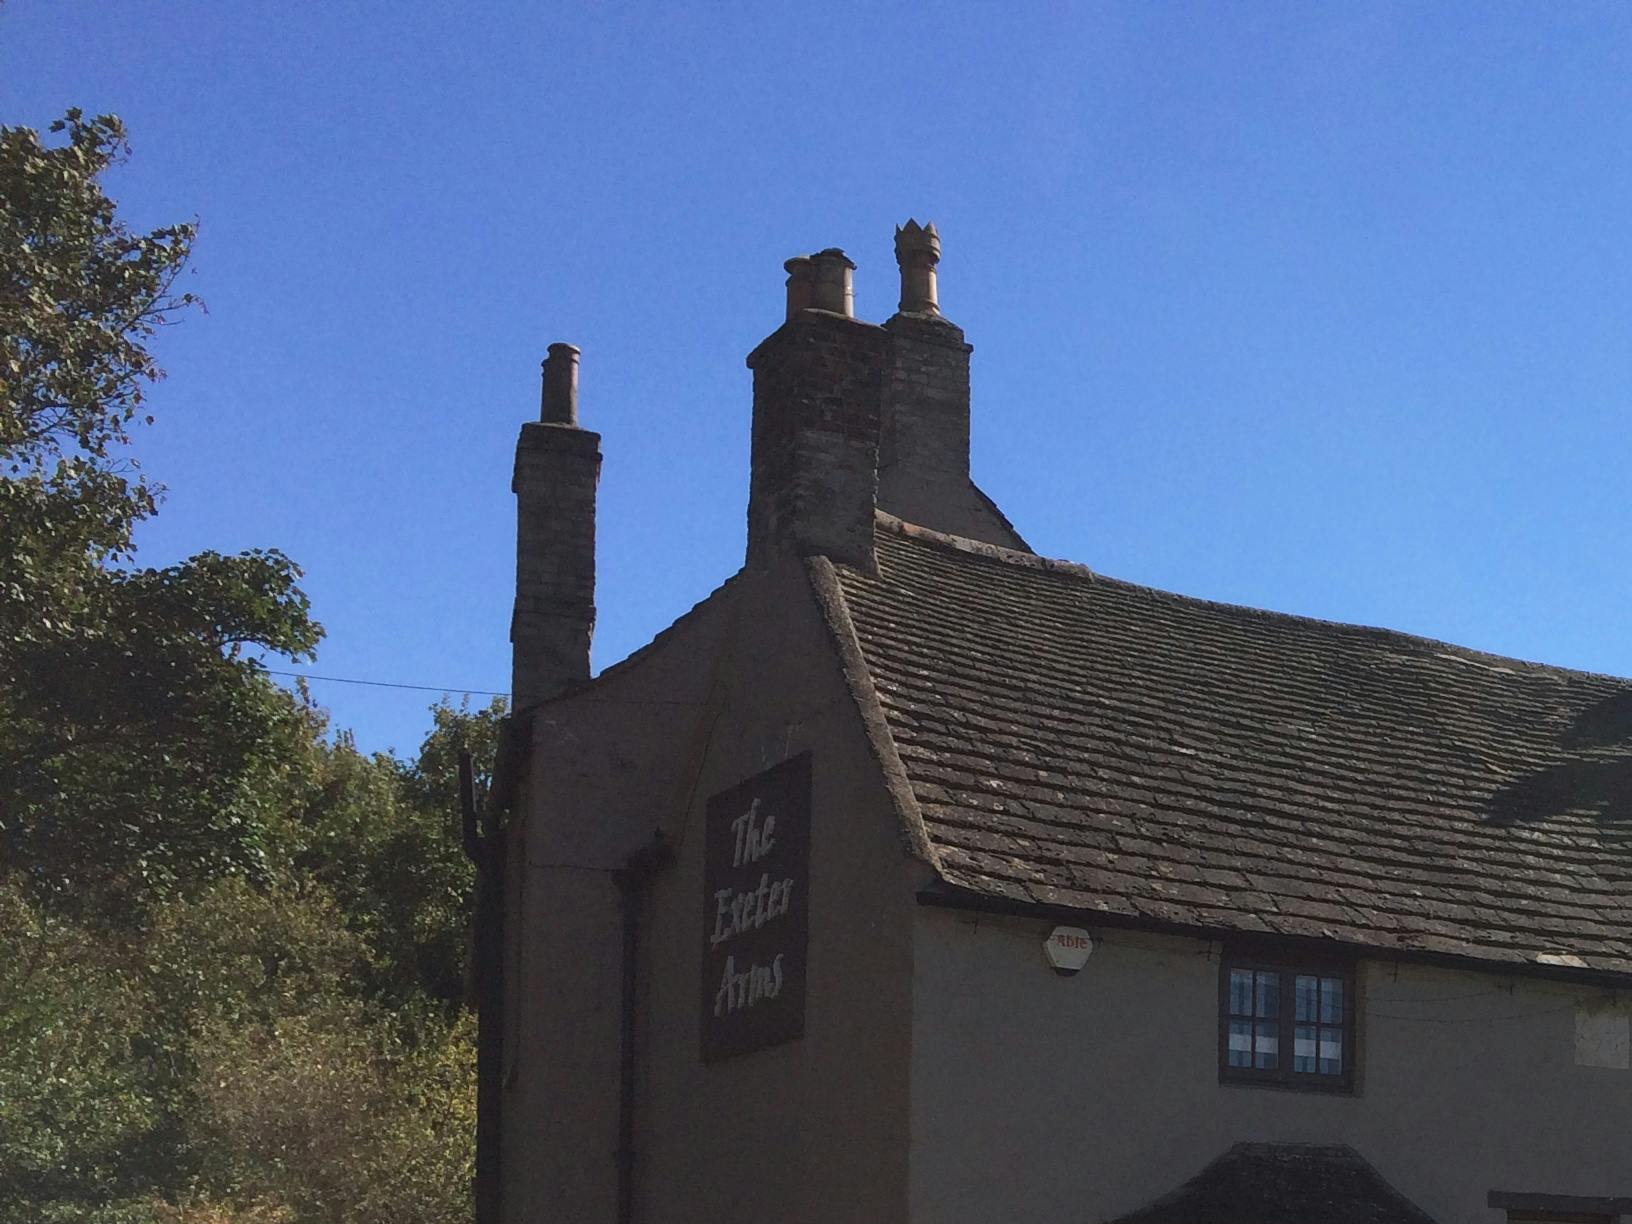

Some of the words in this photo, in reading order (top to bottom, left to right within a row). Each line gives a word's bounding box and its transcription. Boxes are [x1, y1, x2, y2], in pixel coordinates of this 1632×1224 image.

[731, 798, 776, 868] The
[710, 872, 794, 944] Exeter
[713, 953, 784, 1017] Arms
